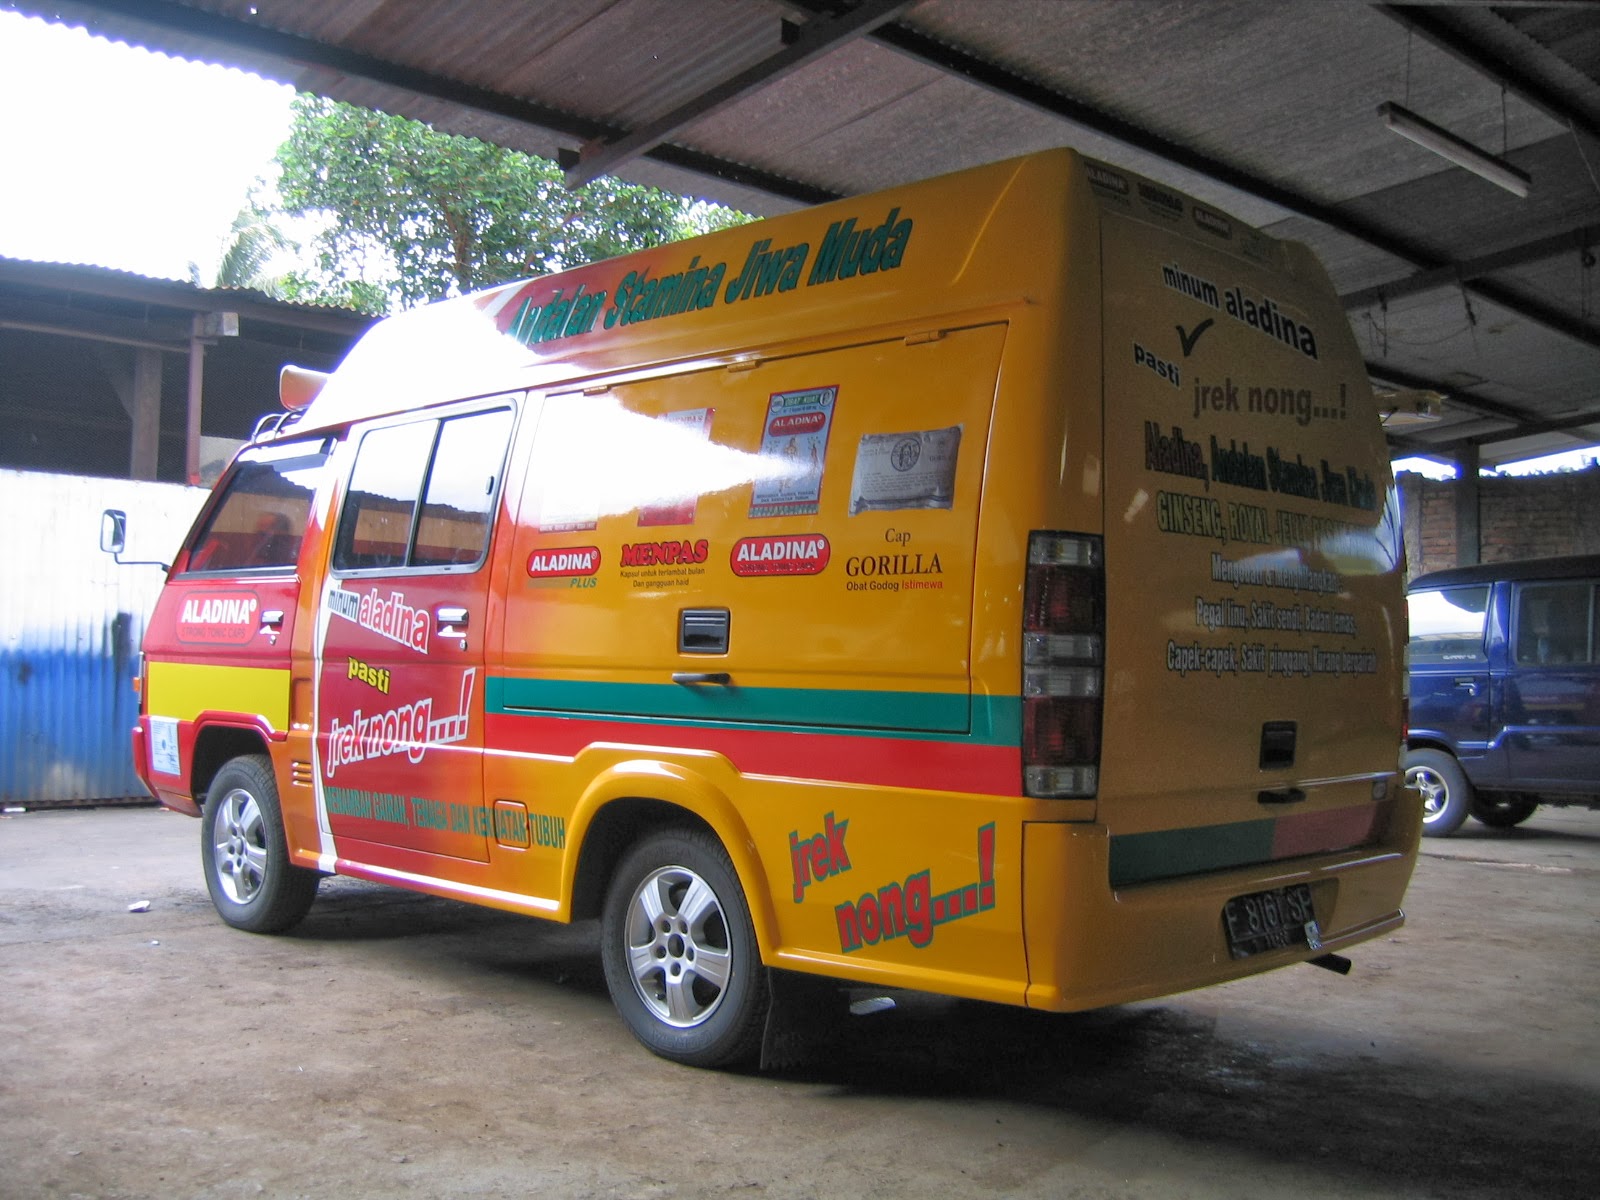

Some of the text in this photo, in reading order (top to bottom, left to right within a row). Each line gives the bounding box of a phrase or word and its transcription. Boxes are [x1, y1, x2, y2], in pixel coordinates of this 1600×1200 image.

[603, 256, 728, 331] Stamina
[723, 238, 811, 304] Jiwa
[807, 207, 914, 287] Muda
[1161, 264, 1318, 360] minum aladina
[1133, 342, 1181, 388] pasti
[1192, 377, 1240, 420] jrek
[1157, 489, 1228, 545] GINSENG,
[1228, 502, 1272, 544] ROYAL
[620, 540, 709, 568] MENPAS
[737, 540, 820, 562] ALADINA
[885, 528, 911, 548] Cap
[531, 551, 593, 572] ALADINA
[640, 569, 657, 577] untuk
[688, 567, 705, 575] bulan
[846, 553, 943, 577] GORILLA
[569, 577, 598, 588] PLUS
[633, 579, 645, 588] Dan
[675, 578, 690, 586] haid
[846, 579, 943, 593] Obat Godog Istimewa
[181, 599, 251, 625] ALADINA
[328, 588, 431, 655] minum aladina
[1195, 597, 1226, 632] Pegal
[1250, 600, 1277, 631] Sakit
[1240, 642, 1266, 674] Sakit
[347, 656, 391, 694] pasti
[327, 710, 367, 778] jrek
[323, 786, 371, 819] MENAMBAH
[411, 797, 447, 830] TENAGA
[449, 803, 471, 834] DAN
[529, 813, 566, 849] TUBUH
[788, 810, 853, 904] jrek
